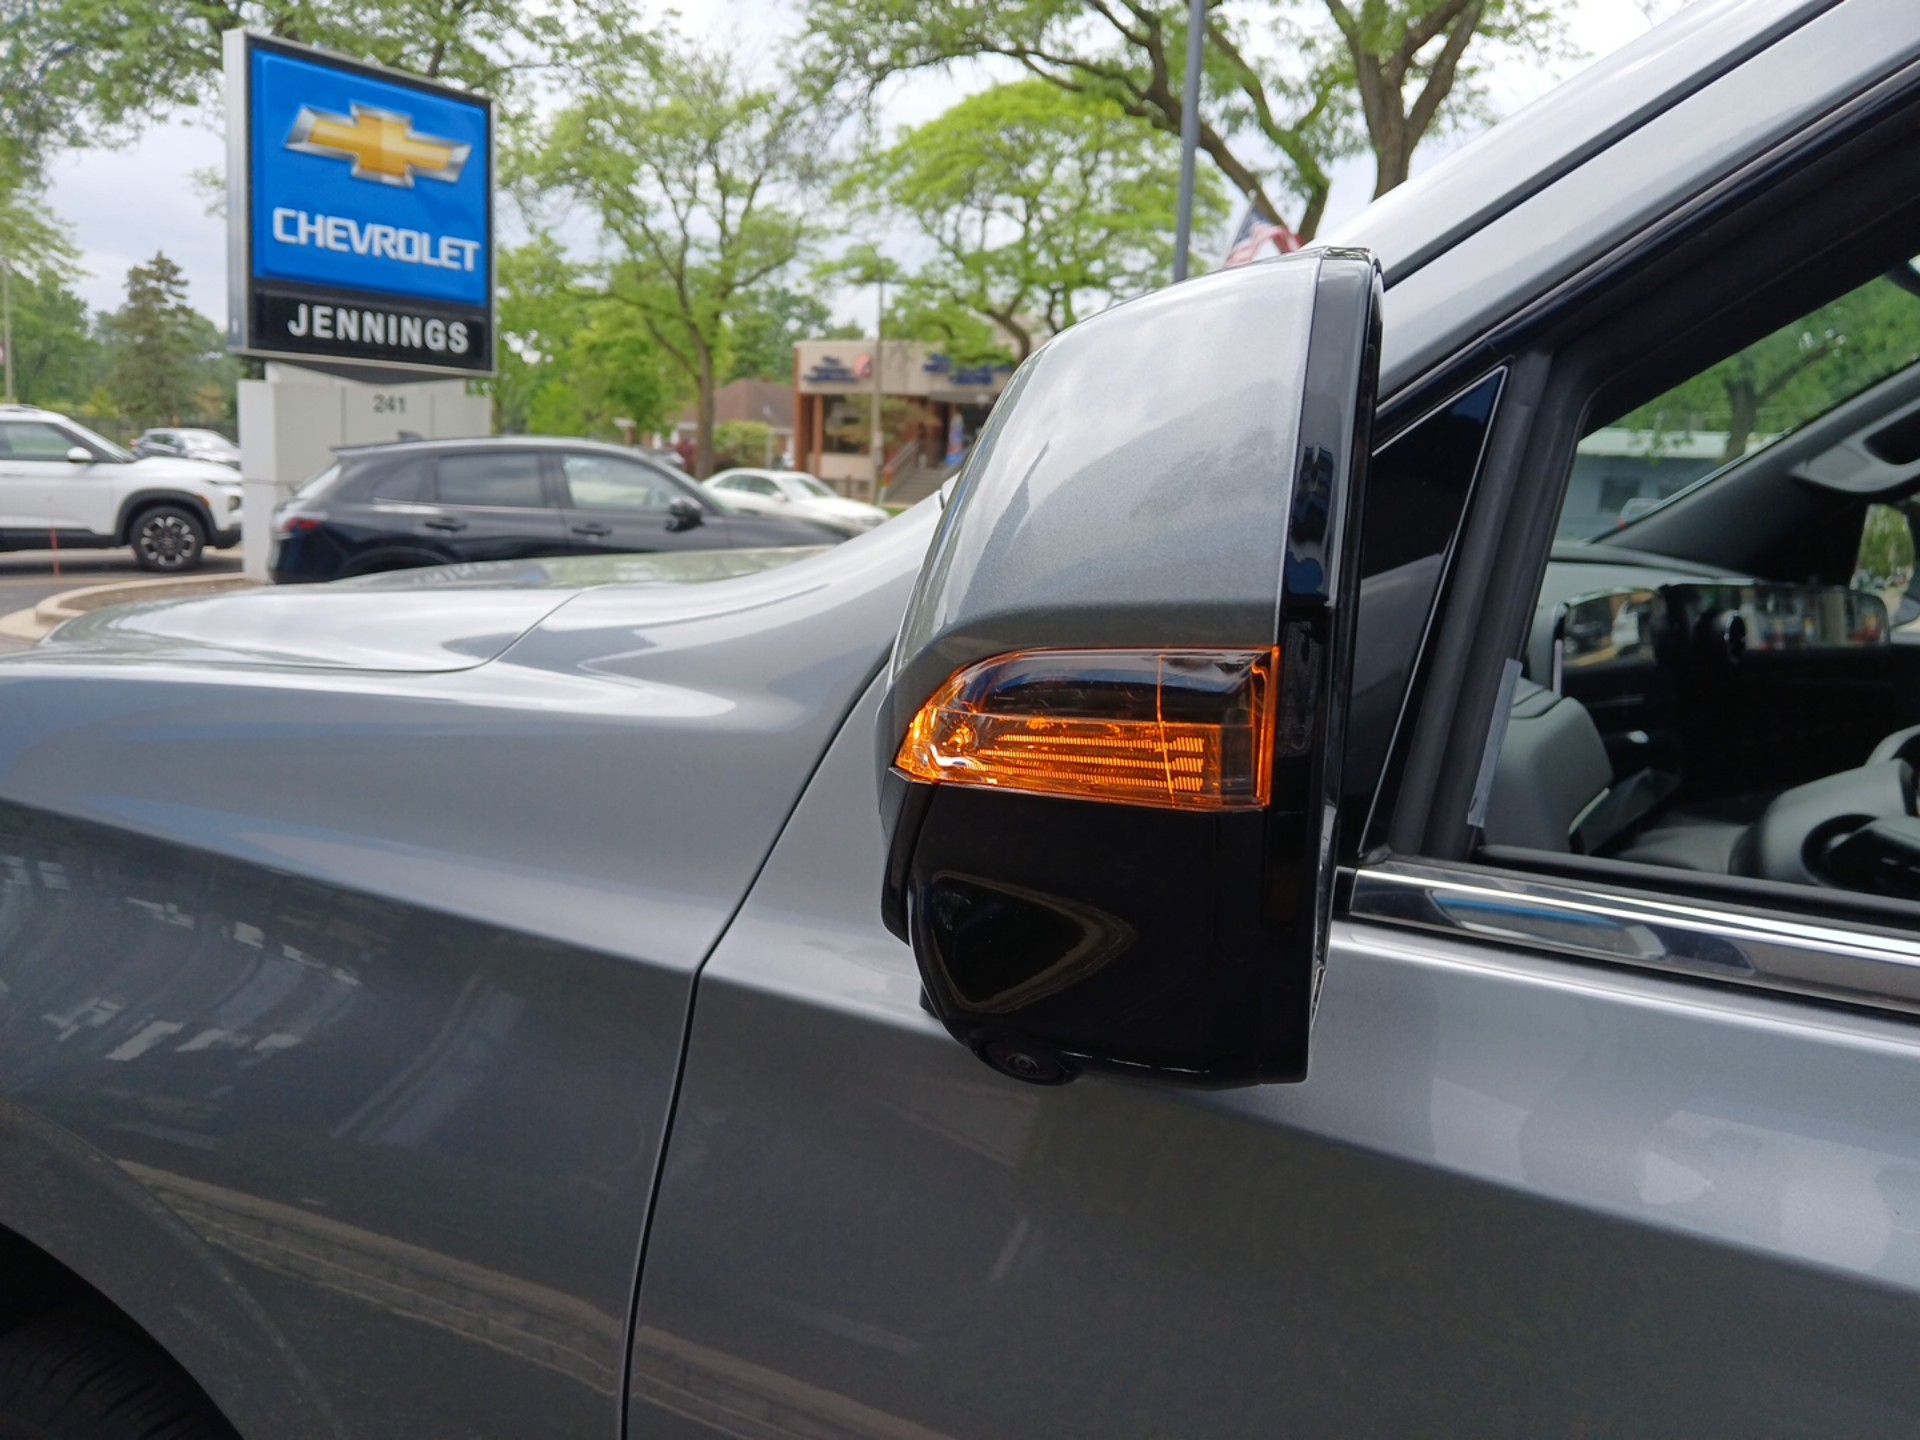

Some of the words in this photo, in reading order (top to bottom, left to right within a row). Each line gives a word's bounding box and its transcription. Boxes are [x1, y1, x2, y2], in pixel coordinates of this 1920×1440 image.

[272, 206, 480, 271] CHEVROLET
[287, 303, 469, 354] JENNINGS
[372, 393, 406, 415] 241
